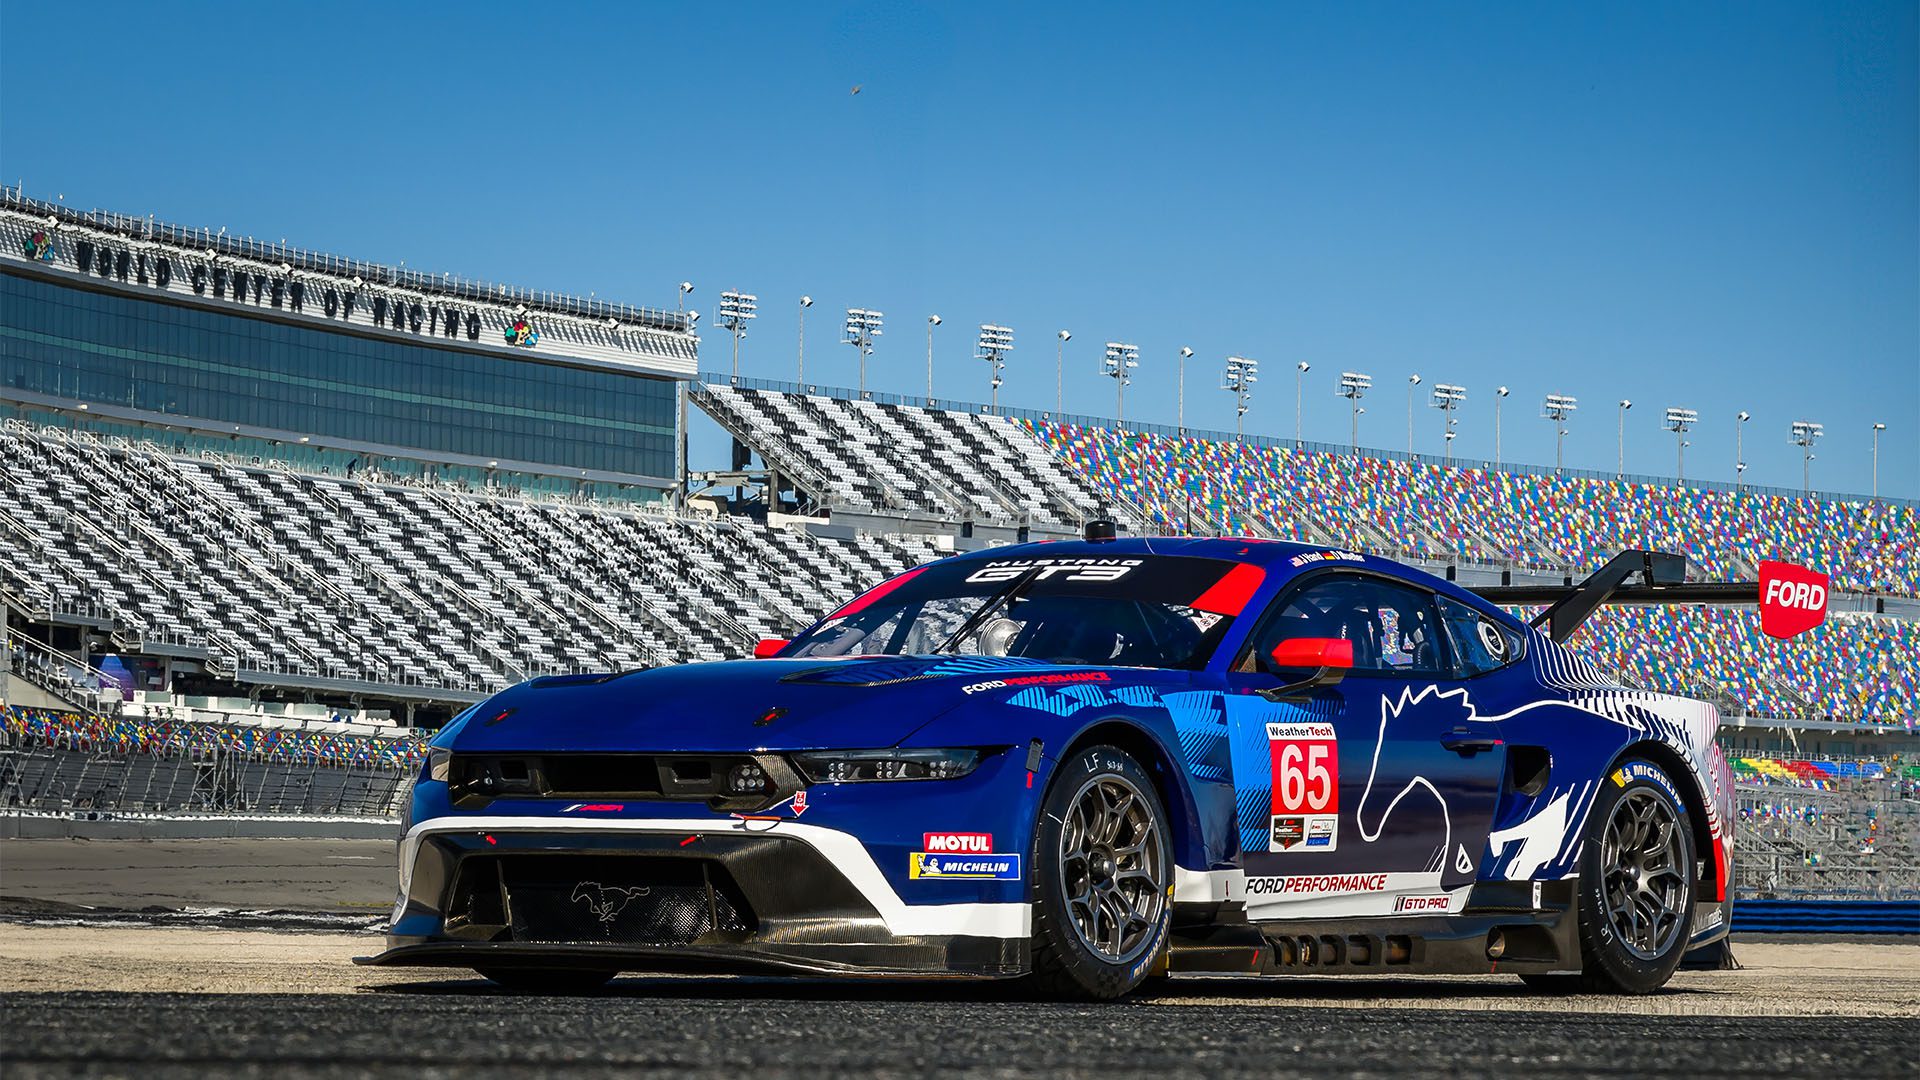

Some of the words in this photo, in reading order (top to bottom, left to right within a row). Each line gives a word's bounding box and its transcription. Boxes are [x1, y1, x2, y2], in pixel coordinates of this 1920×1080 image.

[77, 241, 170, 286] WORLD
[193, 265, 303, 312] CENTER
[324, 288, 355, 320] OF
[373, 298, 480, 340] RACING
[965, 566, 1131, 582] GT3
[1765, 579, 1825, 610] FORD
[1269, 727, 1332, 736] WeatherTech
[1084, 753, 1098, 773] LF
[1281, 744, 1331, 810] 65
[1633, 765, 1682, 806] MICHELIN
[928, 835, 989, 851] MOTUL
[943, 862, 1009, 872] MICHELIN
[1405, 898, 1426, 909] GTD
[1427, 898, 1449, 908] PRO
